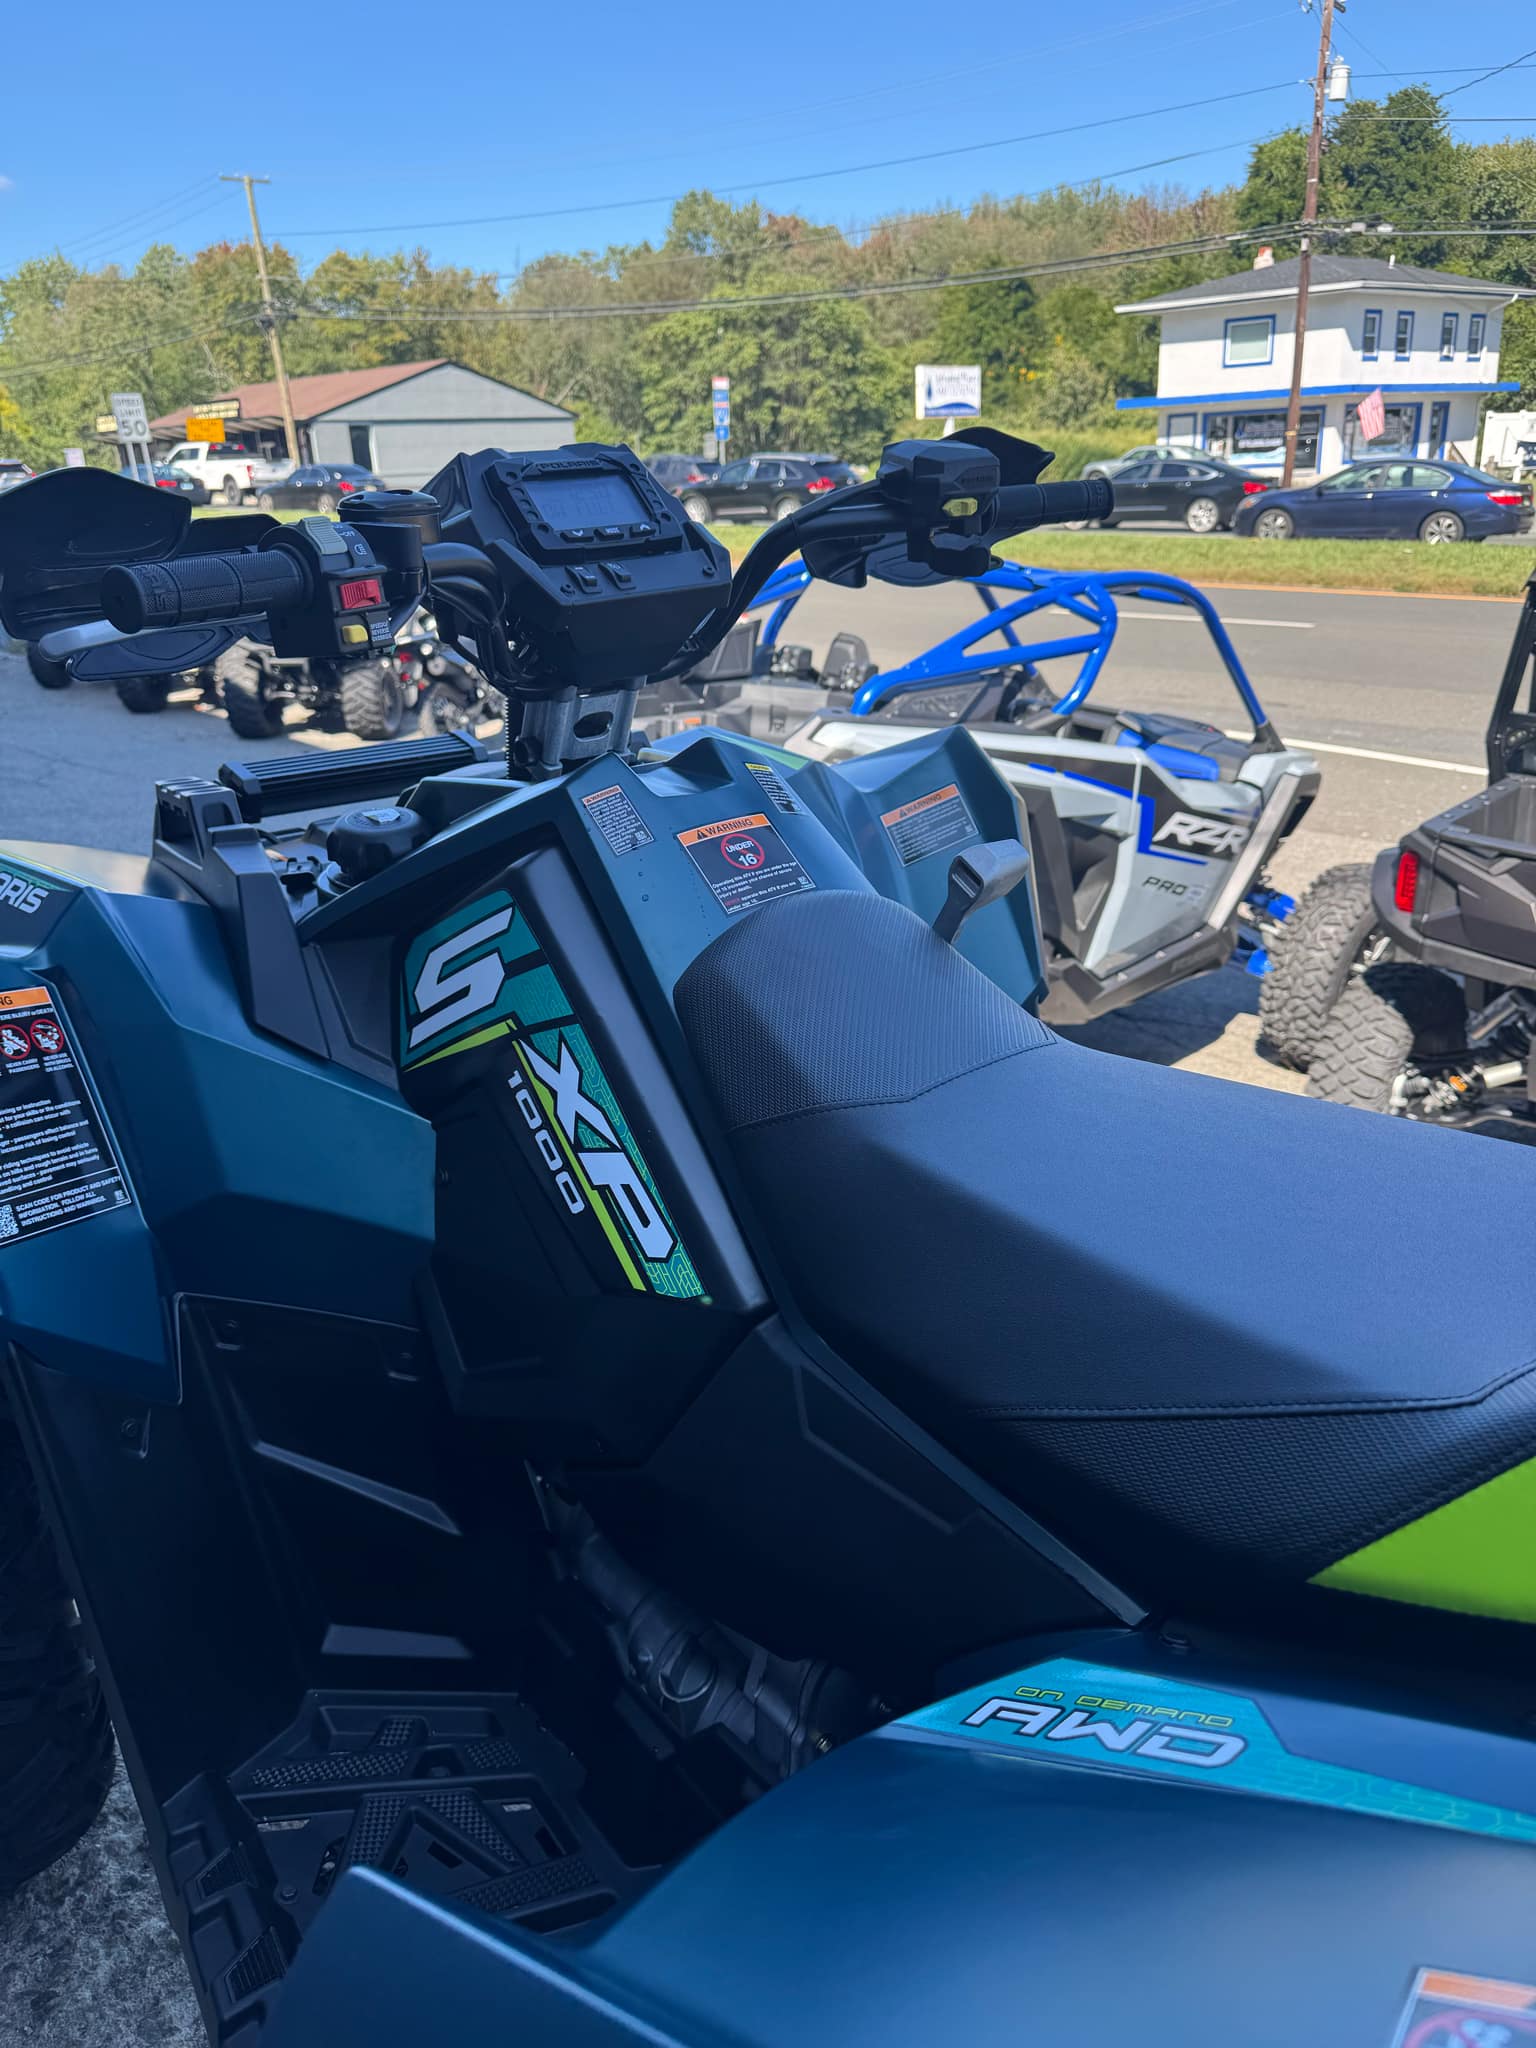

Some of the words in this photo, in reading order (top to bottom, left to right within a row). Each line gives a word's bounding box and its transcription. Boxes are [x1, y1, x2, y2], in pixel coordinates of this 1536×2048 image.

[121, 420, 147, 436] 50
[539, 460, 600, 469] POLARIS
[704, 818, 753, 835] WARNING
[1152, 811, 1249, 854] RZR
[725, 841, 754, 853] UNDER
[739, 853, 758, 866] 16
[1142, 876, 1188, 896] PRO
[408, 907, 515, 1049] S
[508, 1070, 585, 1214] 1000
[519, 1038, 676, 1259] XP
[15, 1201, 33, 1212] SCAN
[33, 1196, 51, 1207] CODE
[50, 1193, 63, 1201] FOR
[62, 1185, 89, 1198] PRODUCT
[89, 1181, 101, 1189] AND
[61, 1194, 85, 1206] FOLLOW
[21, 1208, 64, 1227] INSTRUCTIONS
[63, 1204, 76, 1213] AND
[1016, 1687, 1064, 1701] ON
[1076, 1695, 1233, 1728] DEMAND
[963, 1697, 1246, 1767] AWD
